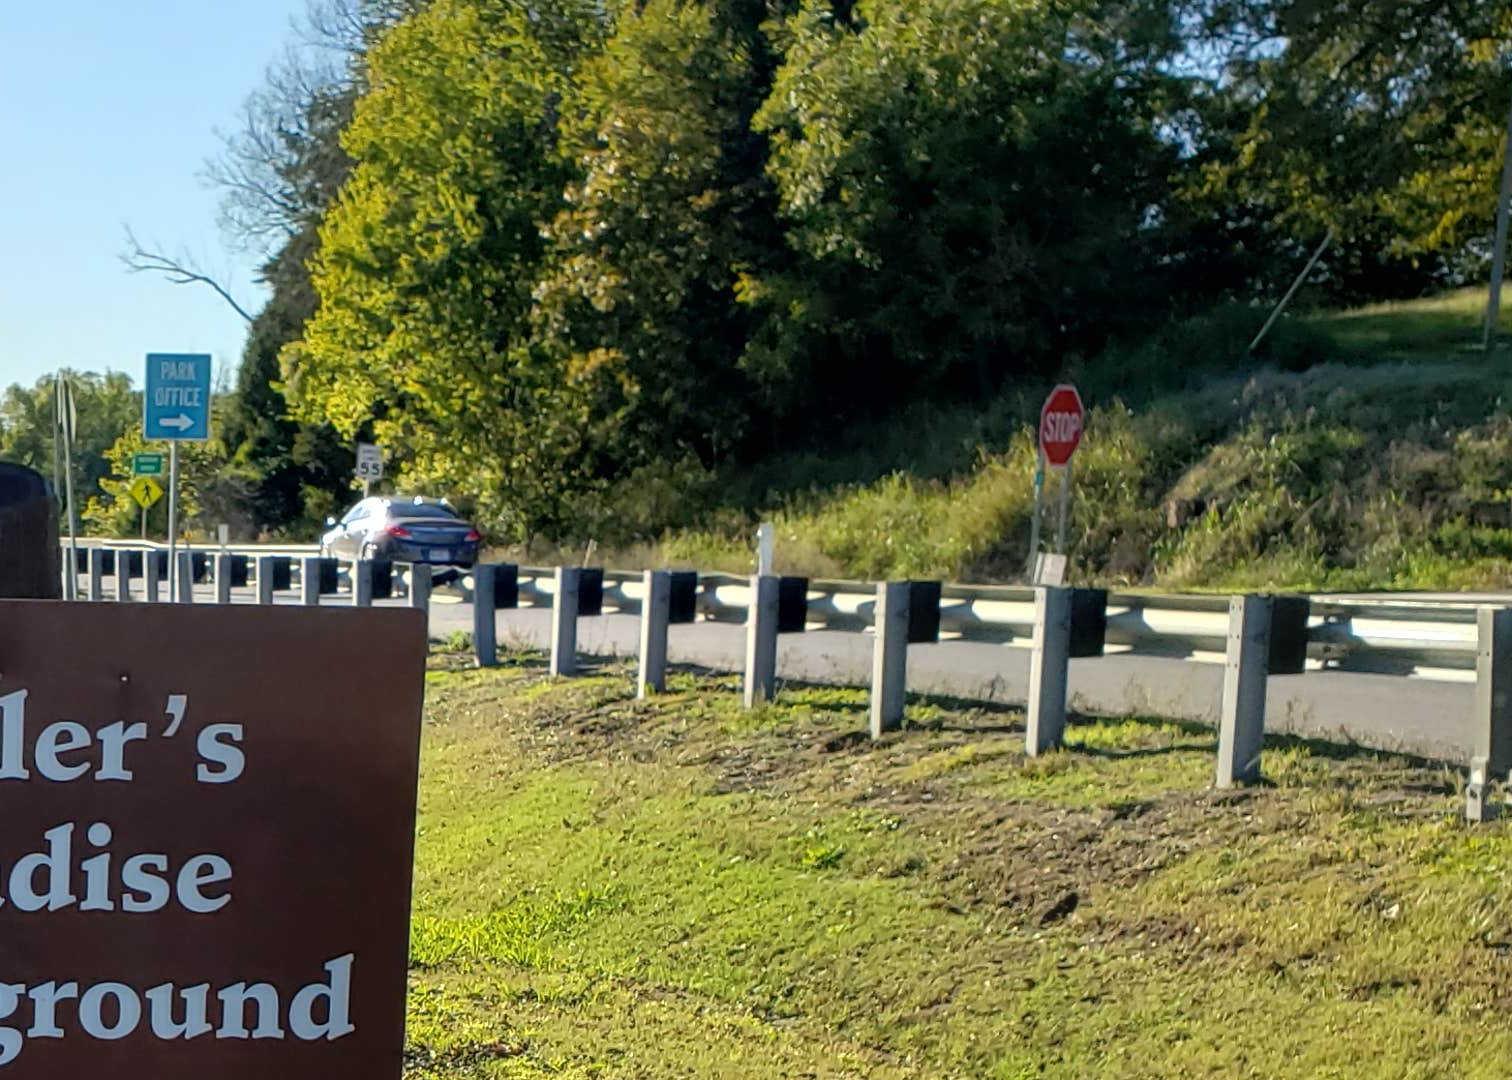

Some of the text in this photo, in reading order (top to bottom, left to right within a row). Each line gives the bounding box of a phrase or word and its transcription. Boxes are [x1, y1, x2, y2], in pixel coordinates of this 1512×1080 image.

[160, 361, 196, 380] PARK
[154, 387, 201, 407] OFFICE
[1044, 412, 1080, 443] STOP
[360, 462, 380, 476] 55
